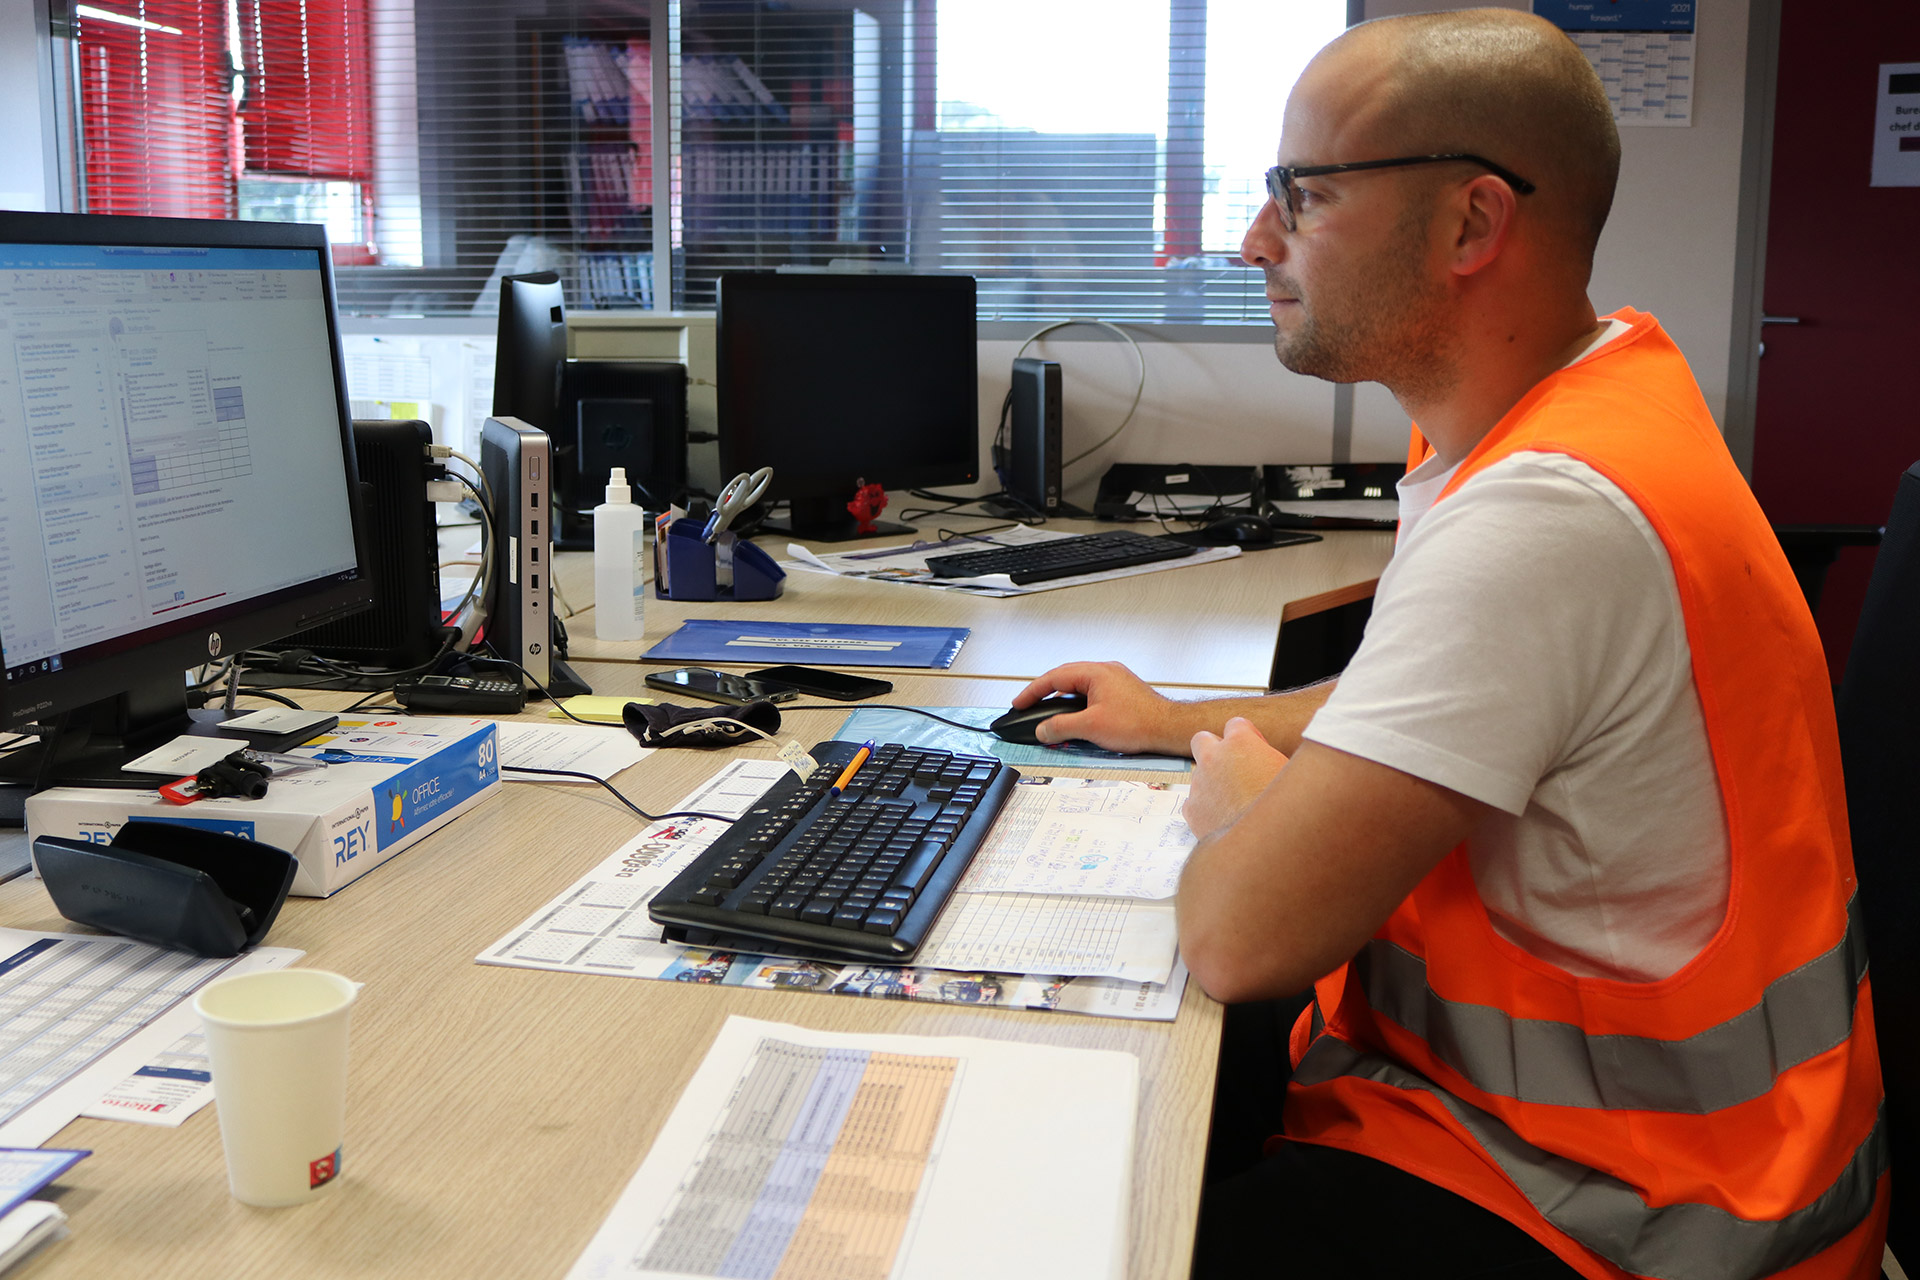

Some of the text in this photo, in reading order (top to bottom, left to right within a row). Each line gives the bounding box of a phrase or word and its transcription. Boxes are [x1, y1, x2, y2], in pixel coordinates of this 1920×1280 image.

[1671, 4, 1690, 12] 2021
[1895, 106, 1920, 115] Bure
[1889, 122, 1912, 131] chef
[209, 632, 222, 657] hp
[529, 643, 542, 655] hp
[478, 739, 494, 768] 80
[478, 769, 487, 781] A4
[412, 776, 440, 804] OFFICE
[333, 820, 370, 868] REY
